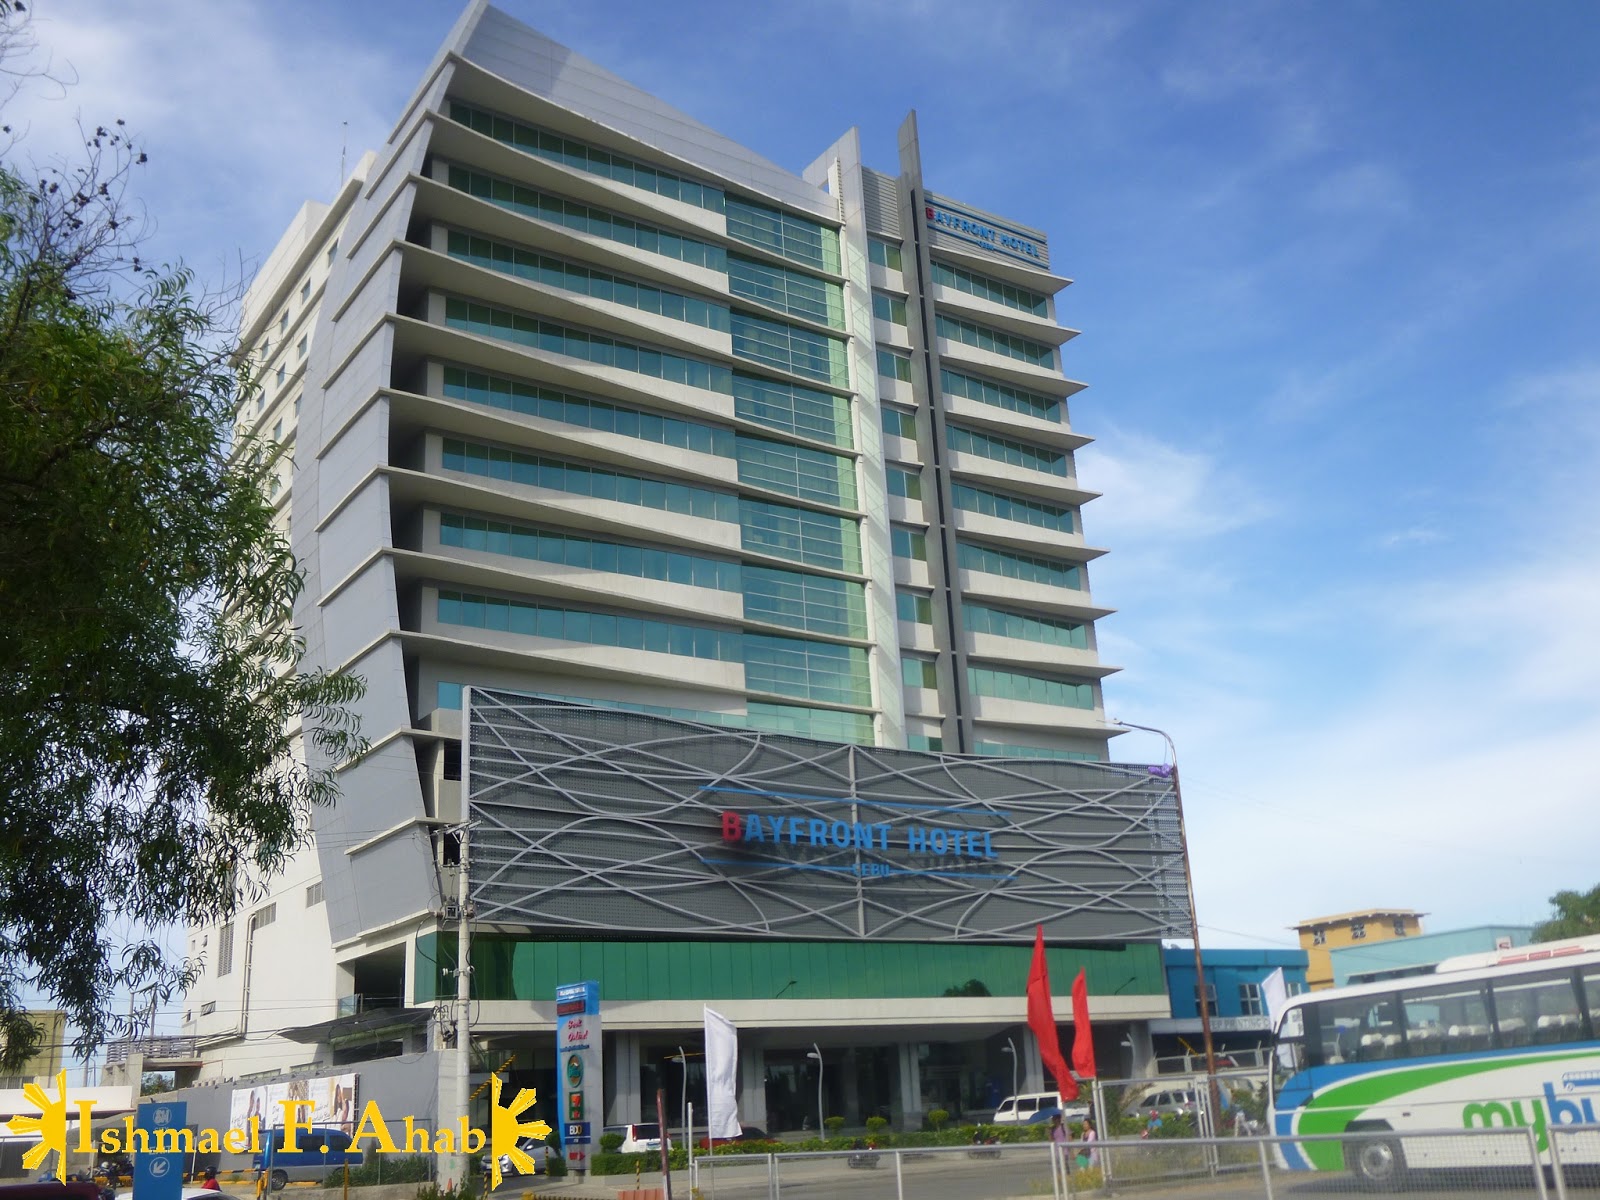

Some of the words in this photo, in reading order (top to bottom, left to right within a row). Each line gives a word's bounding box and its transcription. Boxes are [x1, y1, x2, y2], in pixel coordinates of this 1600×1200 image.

[926, 207, 996, 243] BAYFRONT
[1001, 234, 1041, 258] HOTEL
[722, 811, 893, 850] BAYFRONT
[907, 826, 999, 858] HOTEL
[852, 862, 890, 878] CEBU
